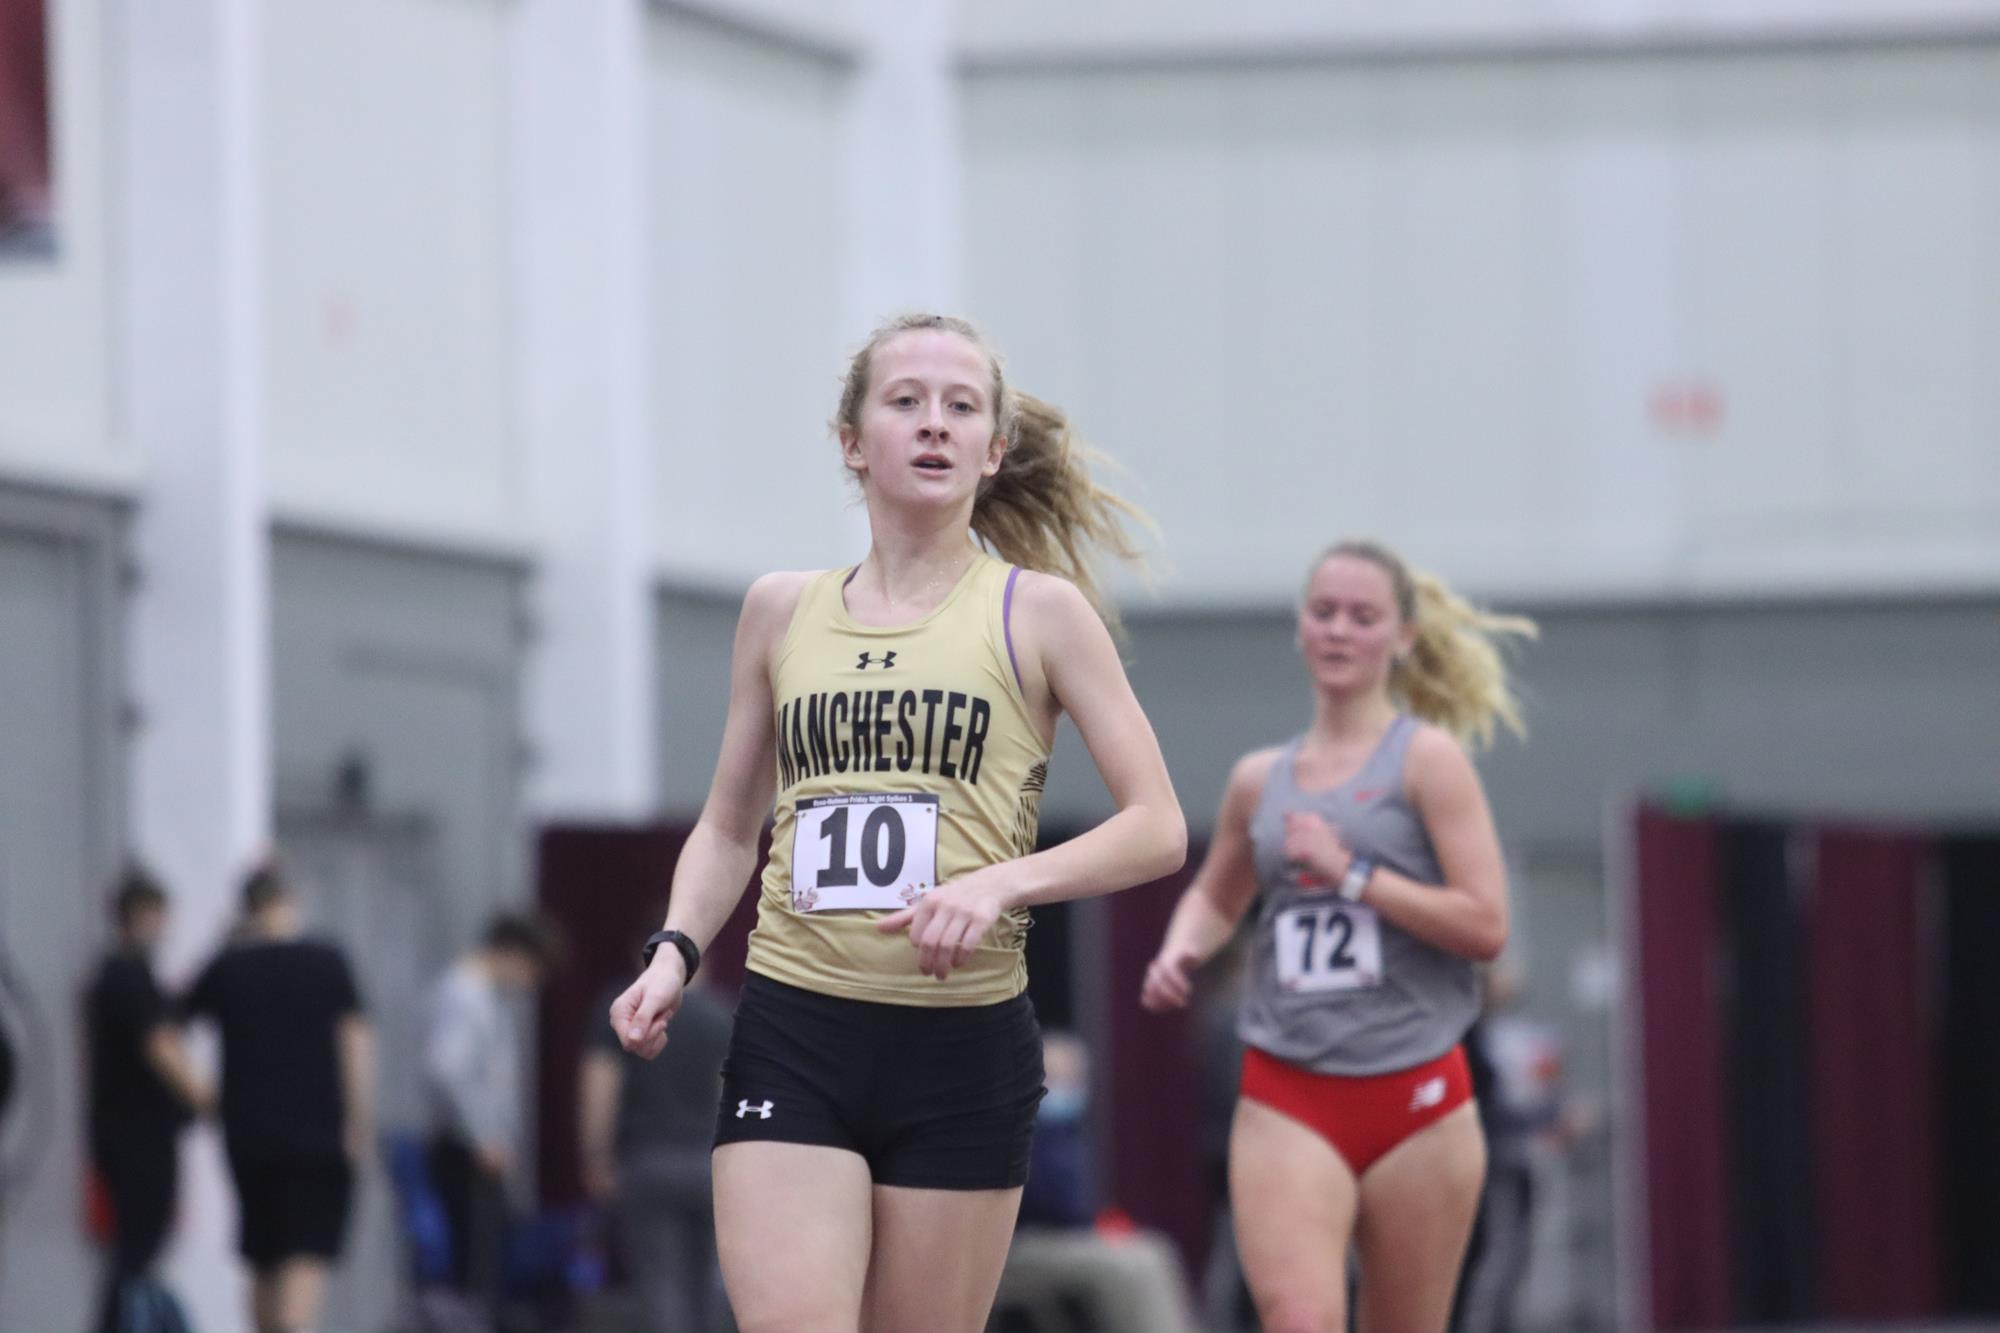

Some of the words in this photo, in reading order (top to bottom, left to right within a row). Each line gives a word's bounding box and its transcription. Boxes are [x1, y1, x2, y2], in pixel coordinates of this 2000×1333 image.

[777, 689, 991, 792] MANCHESTER
[816, 804, 906, 888] 10
[1296, 911, 1356, 974] 72
